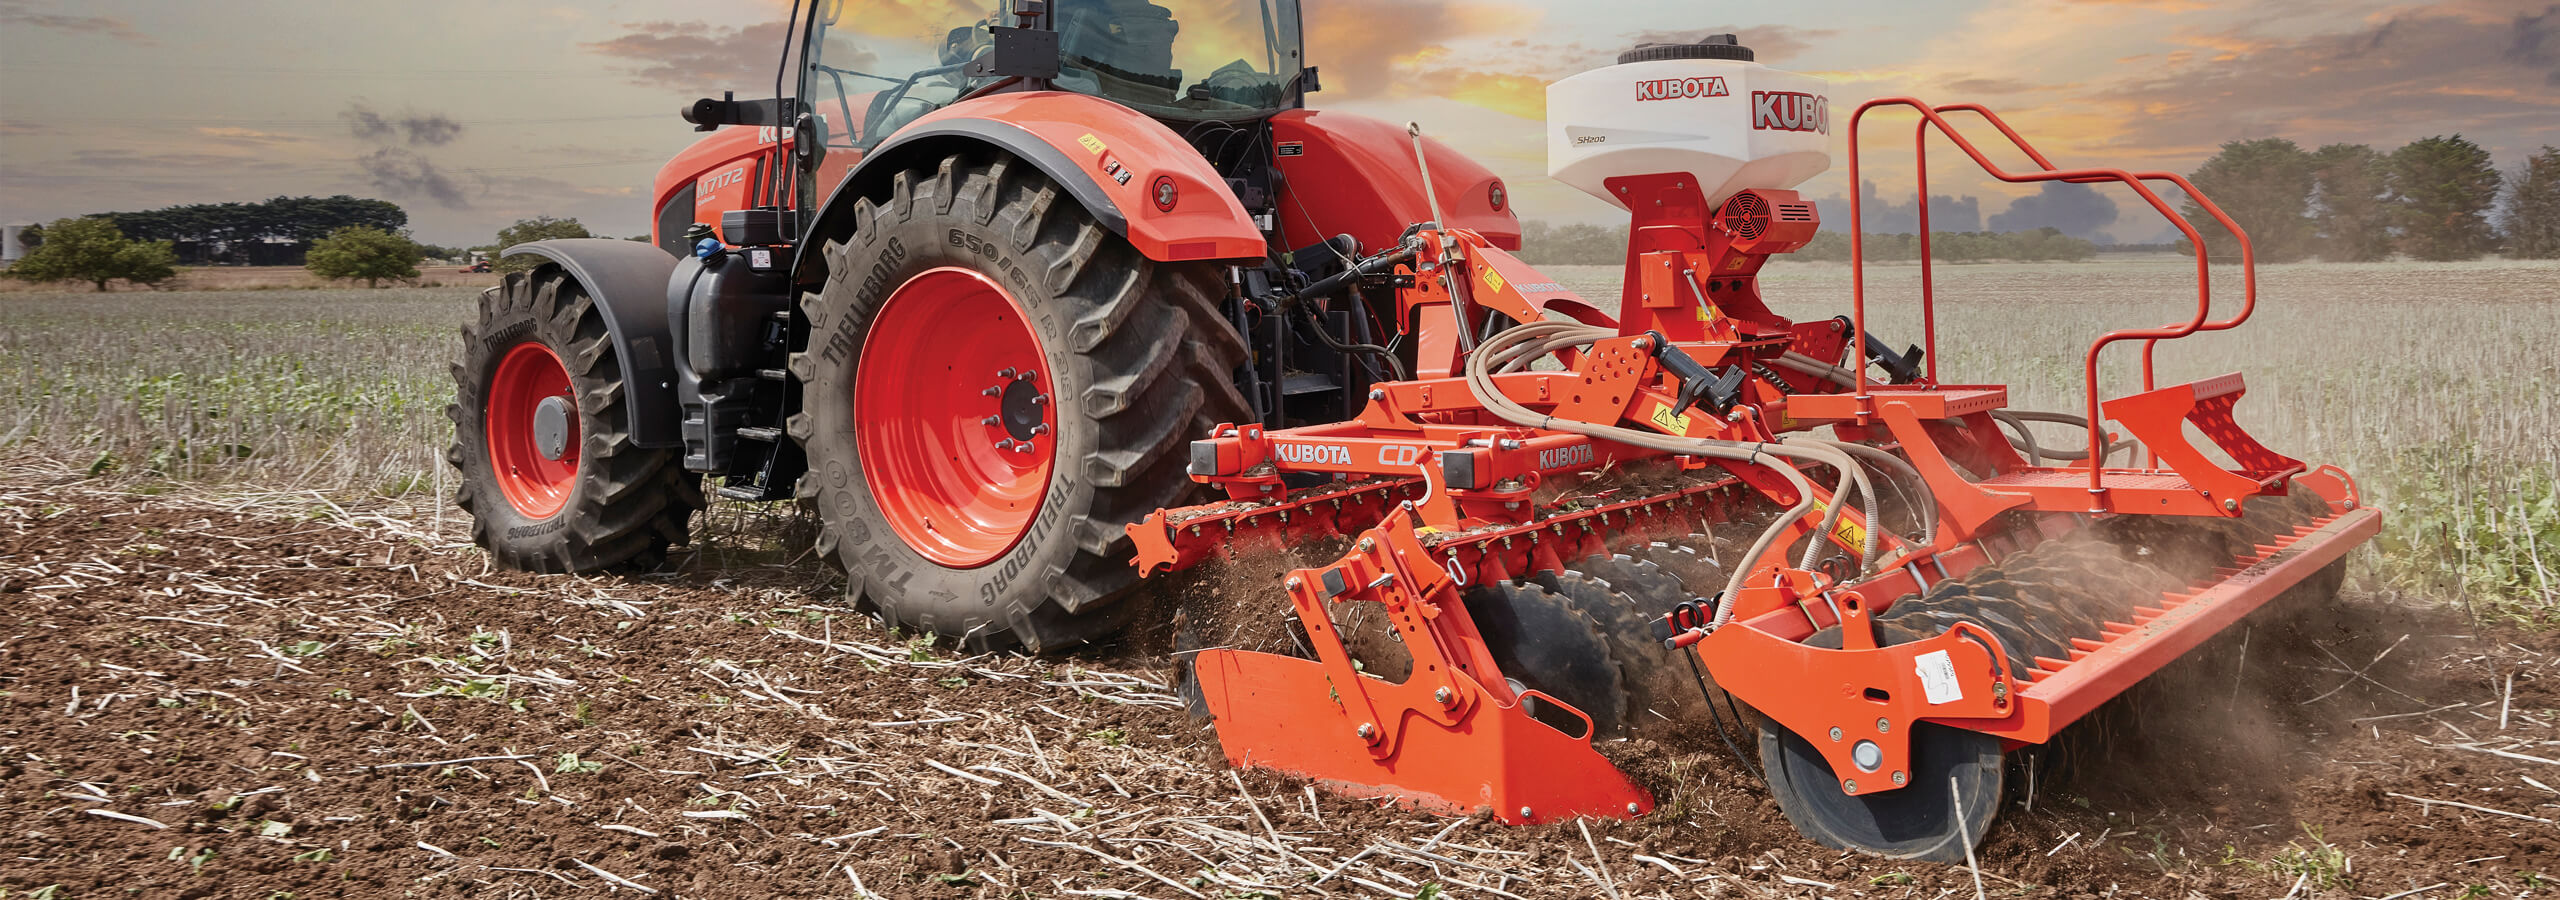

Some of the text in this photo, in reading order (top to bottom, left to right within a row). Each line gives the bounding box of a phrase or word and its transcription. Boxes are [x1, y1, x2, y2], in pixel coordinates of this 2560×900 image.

[1636, 76, 1729, 101] KUBOTA
[1753, 92, 1830, 136] KUBO
[1576, 135, 1606, 145] SH200
[696, 167, 743, 199] M7172
[948, 228, 1042, 310] 650/65
[1041, 314, 1058, 342] R
[1513, 282, 1567, 293] KUBOTA
[821, 236, 906, 367] TRELLEBORG
[482, 316, 538, 353] TRELLEBORG
[1275, 443, 1352, 465] KUBOTA
[1539, 443, 1595, 470] KUBOTA
[506, 512, 566, 541] TRELLEBORG
[980, 473, 1076, 606] TRELLEBORG
